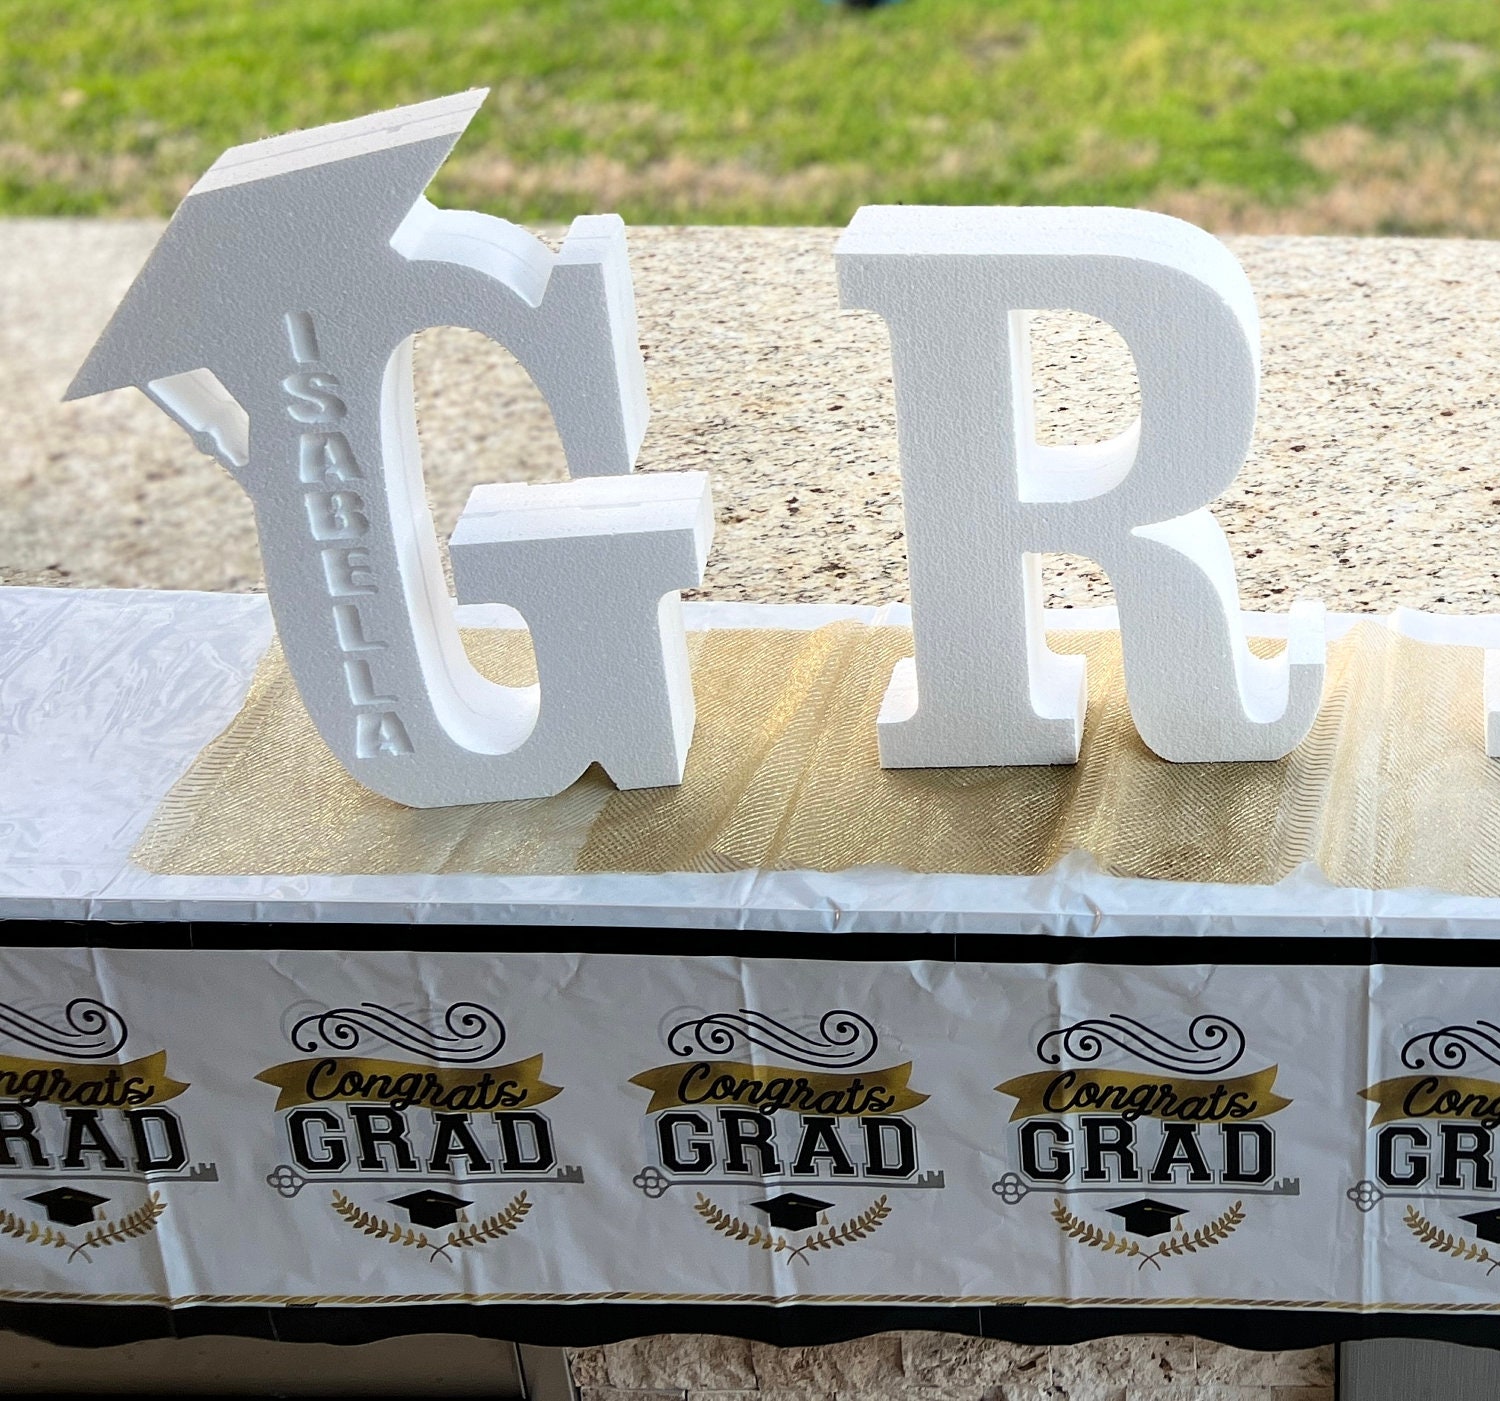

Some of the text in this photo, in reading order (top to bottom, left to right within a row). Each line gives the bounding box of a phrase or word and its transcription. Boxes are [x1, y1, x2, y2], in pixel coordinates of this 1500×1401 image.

[282, 310, 415, 760] ISABELLA
[305, 1059, 529, 1111] Congrats
[677, 1061, 896, 1116] Congrats
[1043, 1069, 1258, 1122] Congrats
[284, 1103, 558, 1174] GRAD
[653, 1108, 922, 1180] GRAD
[1015, 1113, 1277, 1187] GRAD
